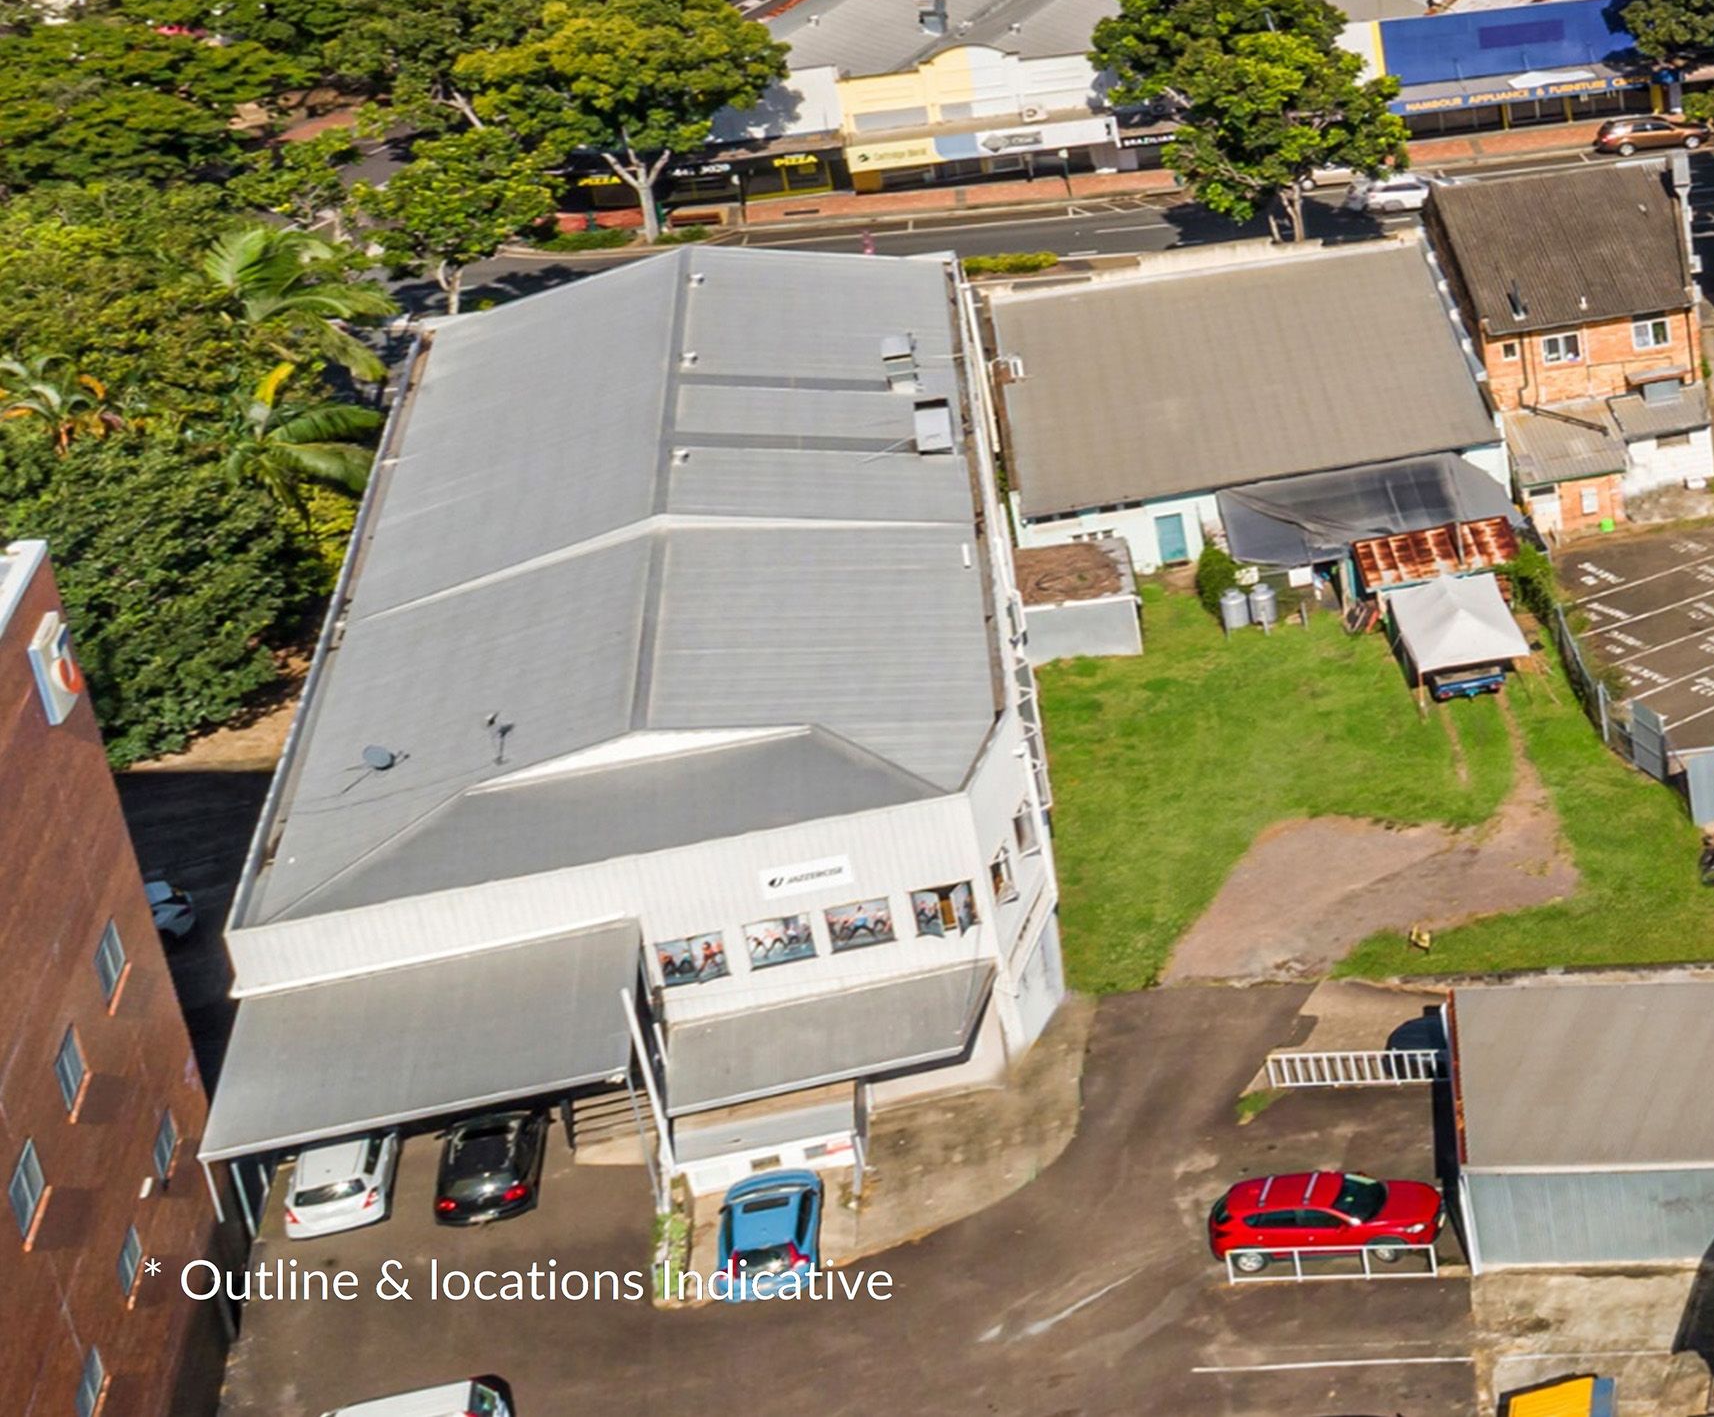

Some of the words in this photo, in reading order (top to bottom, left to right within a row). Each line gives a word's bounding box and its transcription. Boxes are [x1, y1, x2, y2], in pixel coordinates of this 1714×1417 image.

[1406, 96, 1463, 112] NAMBOUR
[1468, 88, 1530, 104] APPLIANCE
[1549, 80, 1607, 95] FURNITURE
[773, 154, 818, 168] PIZZA
